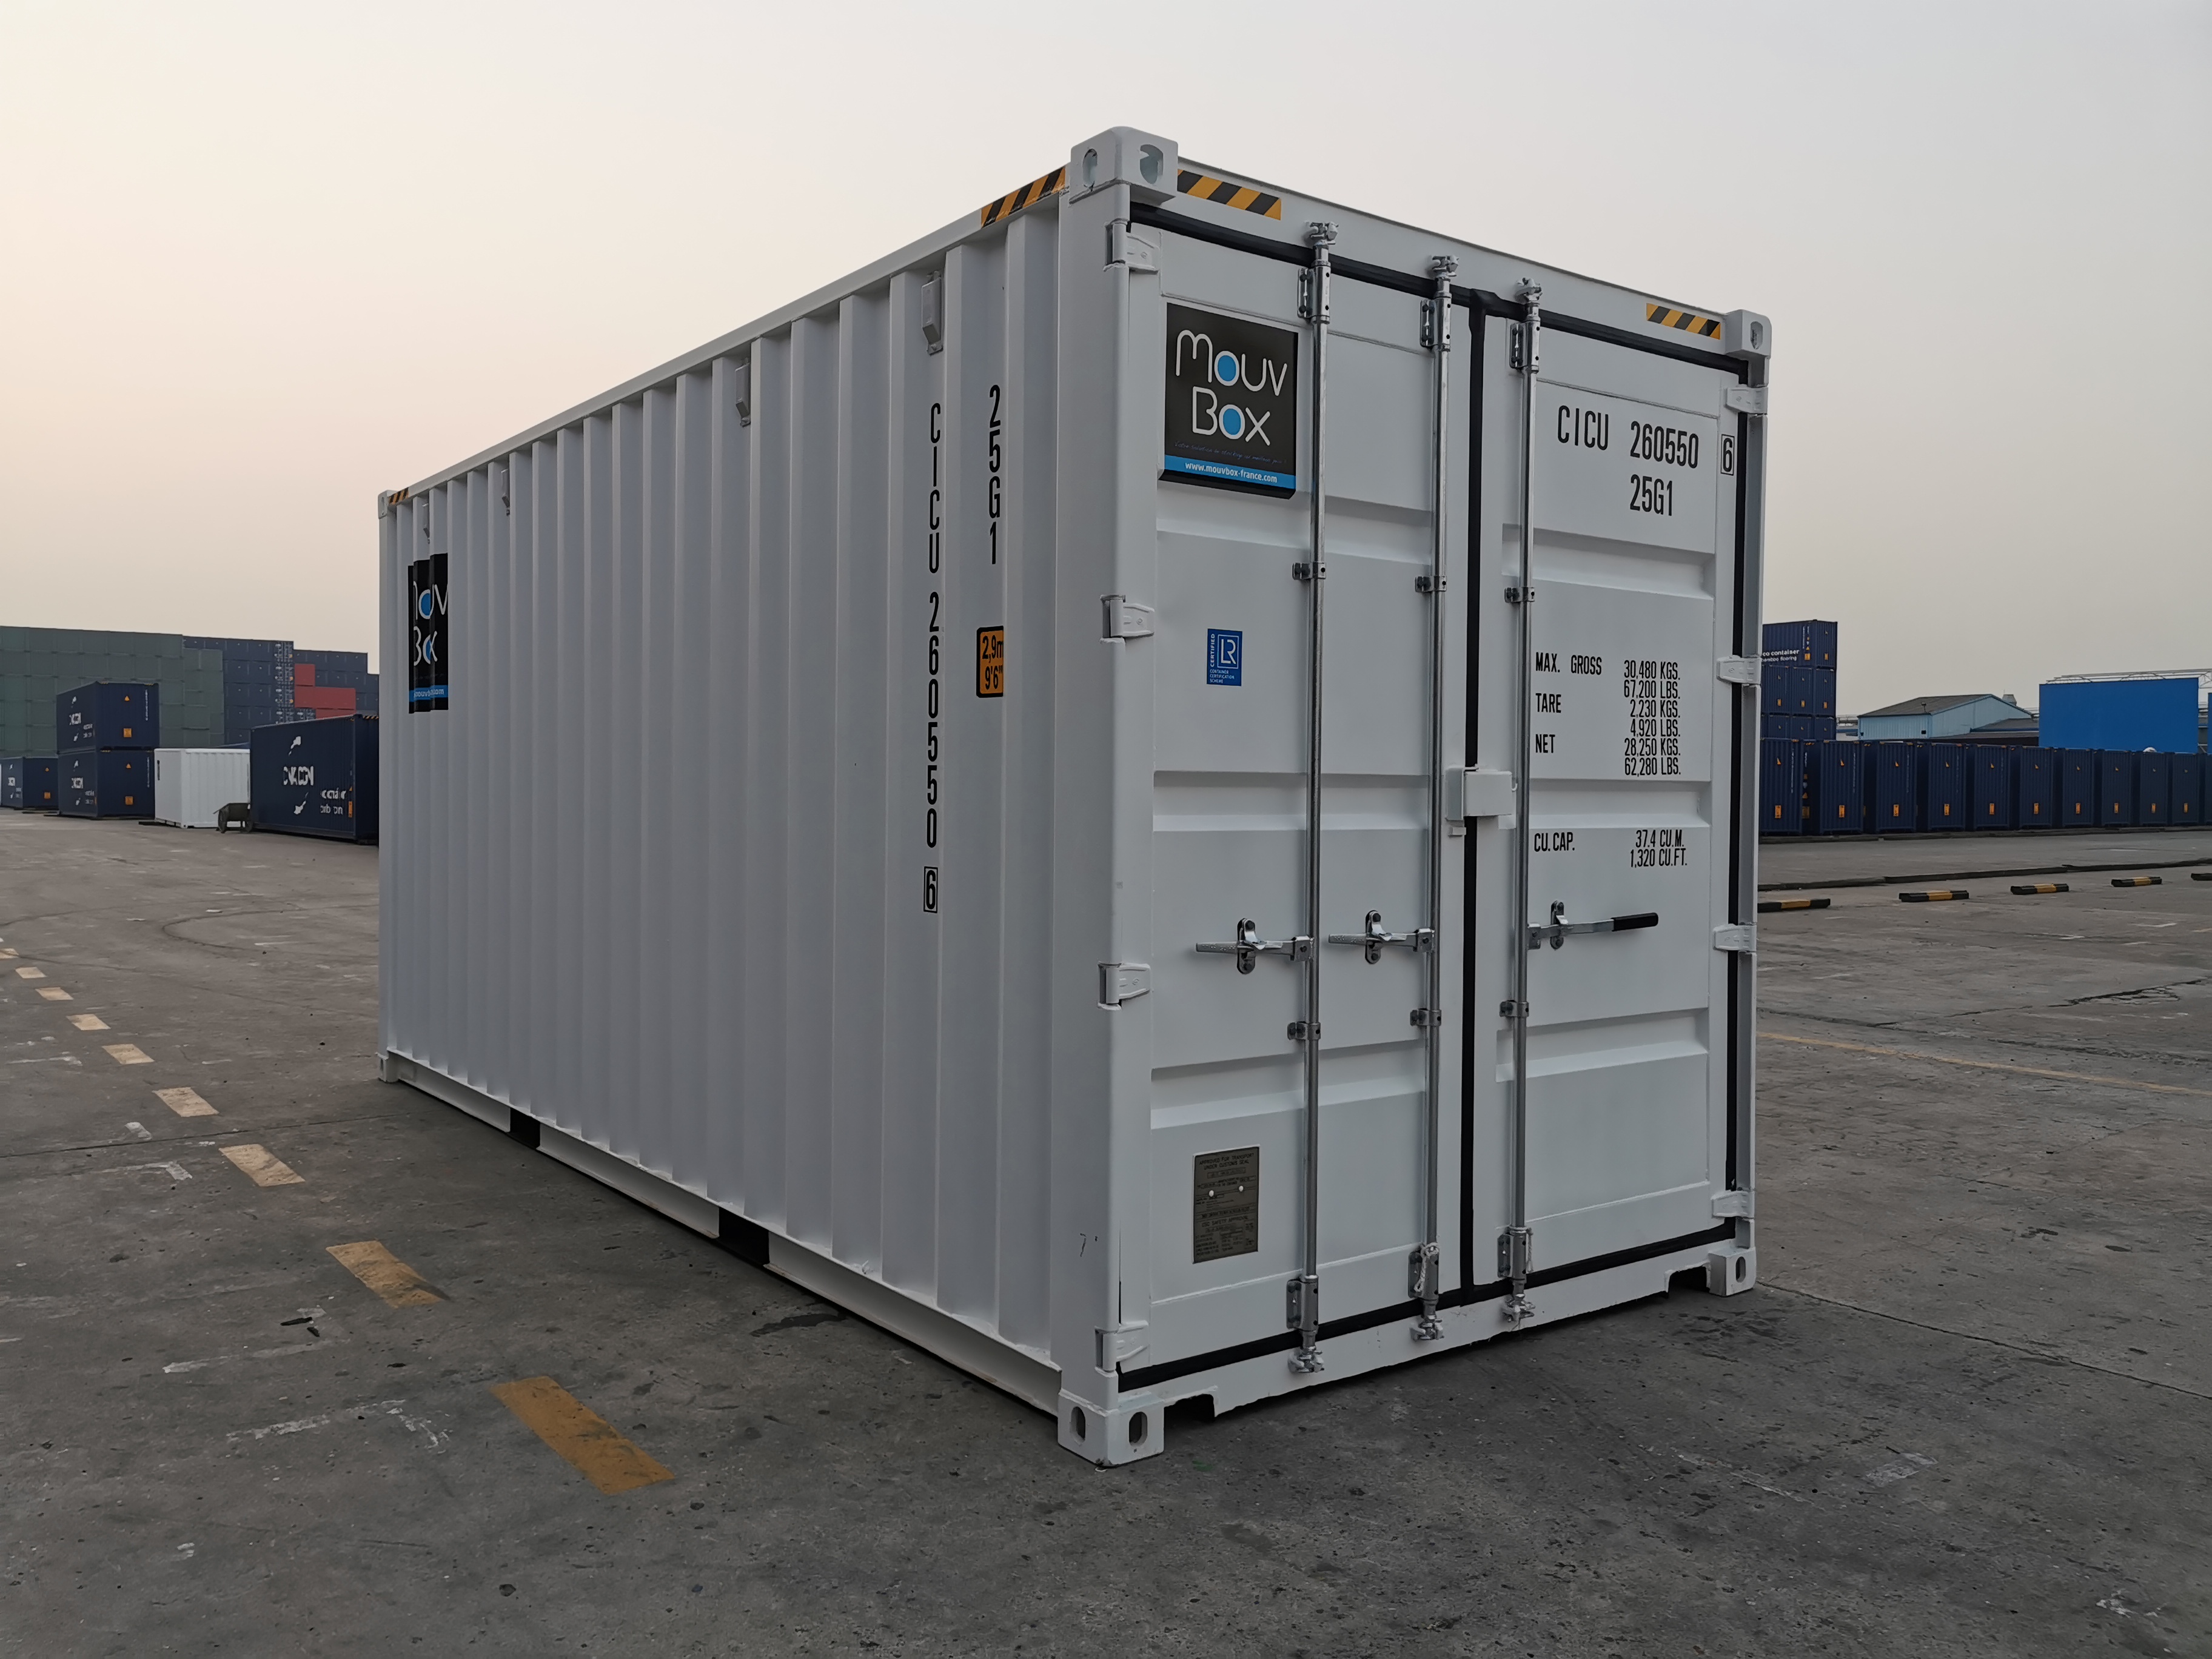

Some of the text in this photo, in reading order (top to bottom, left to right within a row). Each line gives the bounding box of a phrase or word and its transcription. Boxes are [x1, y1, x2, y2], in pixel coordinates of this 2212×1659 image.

[1557, 405, 1733, 472] CICU 260550 6
[989, 384, 1000, 565] 25G1
[1185, 462, 1278, 483] www.mouvbox-france.com
[1630, 474, 1673, 517] 25G1
[926, 403, 940, 910] CICU 260550 6
[1221, 638, 1236, 665] LR
[1535, 652, 1602, 675] MAX. GROSS
[1624, 660, 1681, 680] 30,480 KGS.
[1624, 680, 1681, 699] 67,200 LBS.
[1535, 693, 1561, 714] TARE
[1630, 699, 1681, 719] 2,230 KGS.
[1630, 719, 1681, 737] 4,920 LBS.
[1535, 734, 1555, 753] NET
[1624, 738, 1681, 757] 28,250 KGS.
[1624, 757, 1681, 777] 62,280 LBS.
[1635, 830, 1656, 848] 37.4
[1630, 848, 1655, 868] 1,320
